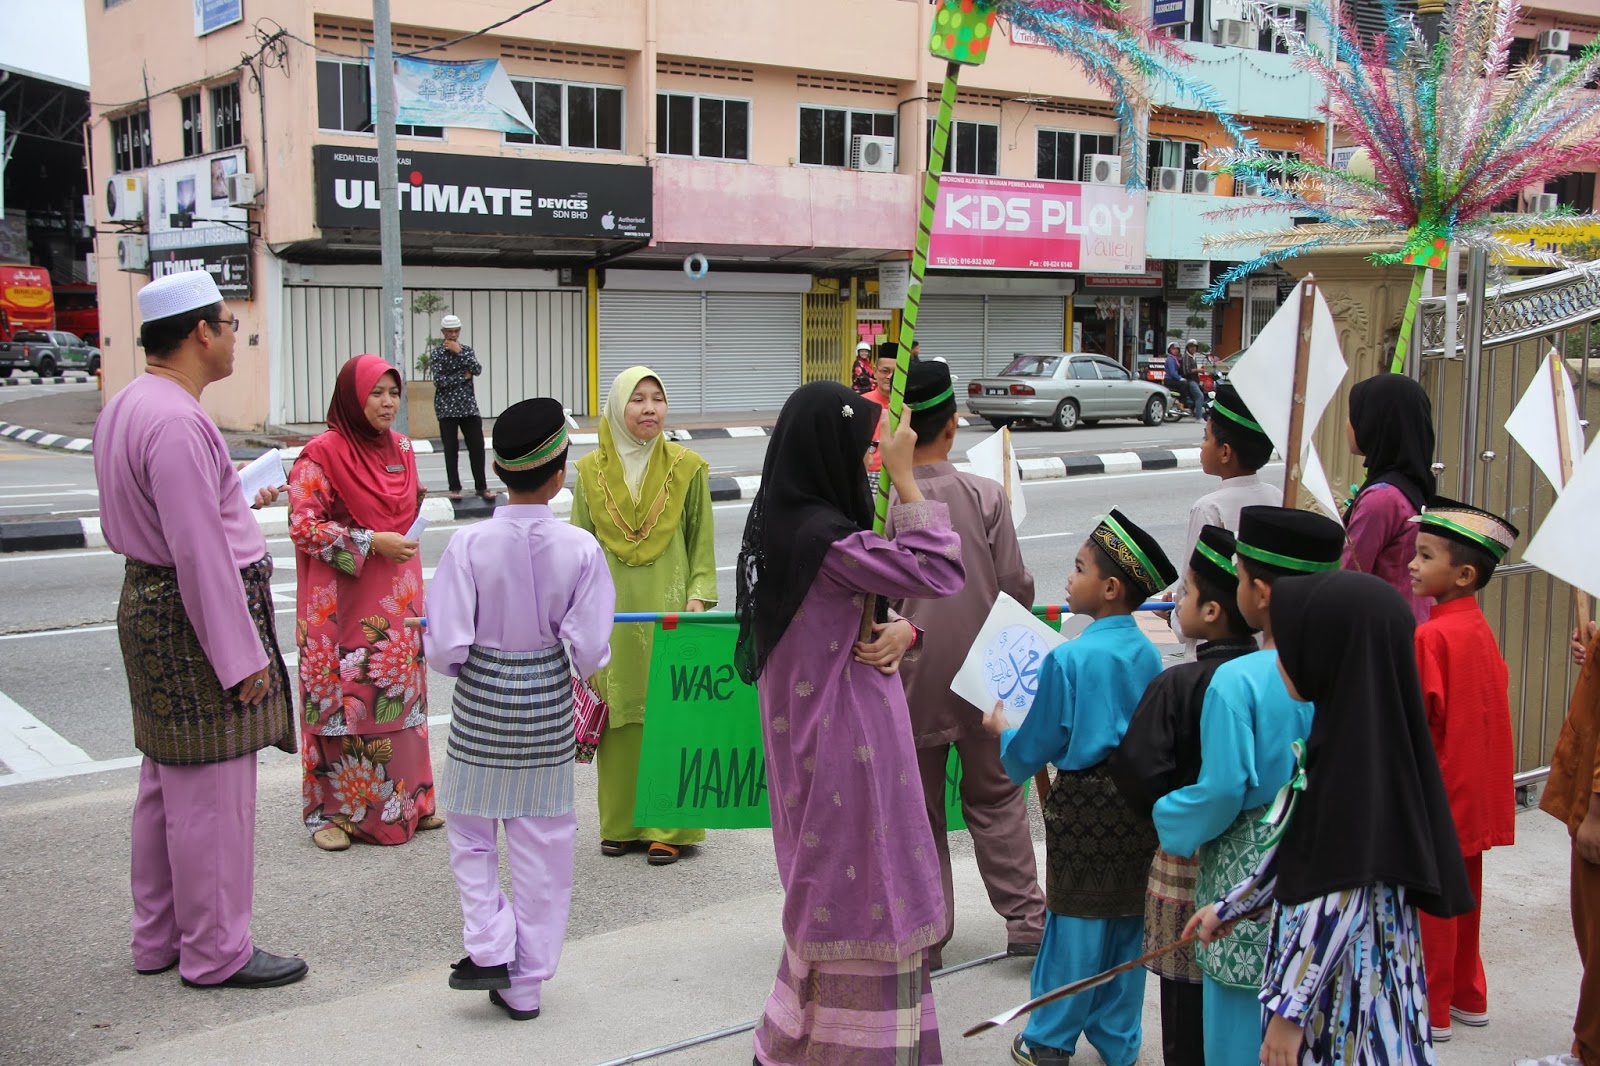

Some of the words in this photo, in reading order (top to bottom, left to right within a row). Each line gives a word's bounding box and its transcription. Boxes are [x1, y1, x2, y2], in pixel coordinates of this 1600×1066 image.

[334, 153, 355, 162] KEDAI
[355, 154, 412, 166] TELEKOKASI
[1008, 181, 1045, 189] PEMBELAJARAN
[538, 198, 588, 210] DEVICES
[553, 210, 570, 219] SDN
[571, 211, 588, 220] BHD
